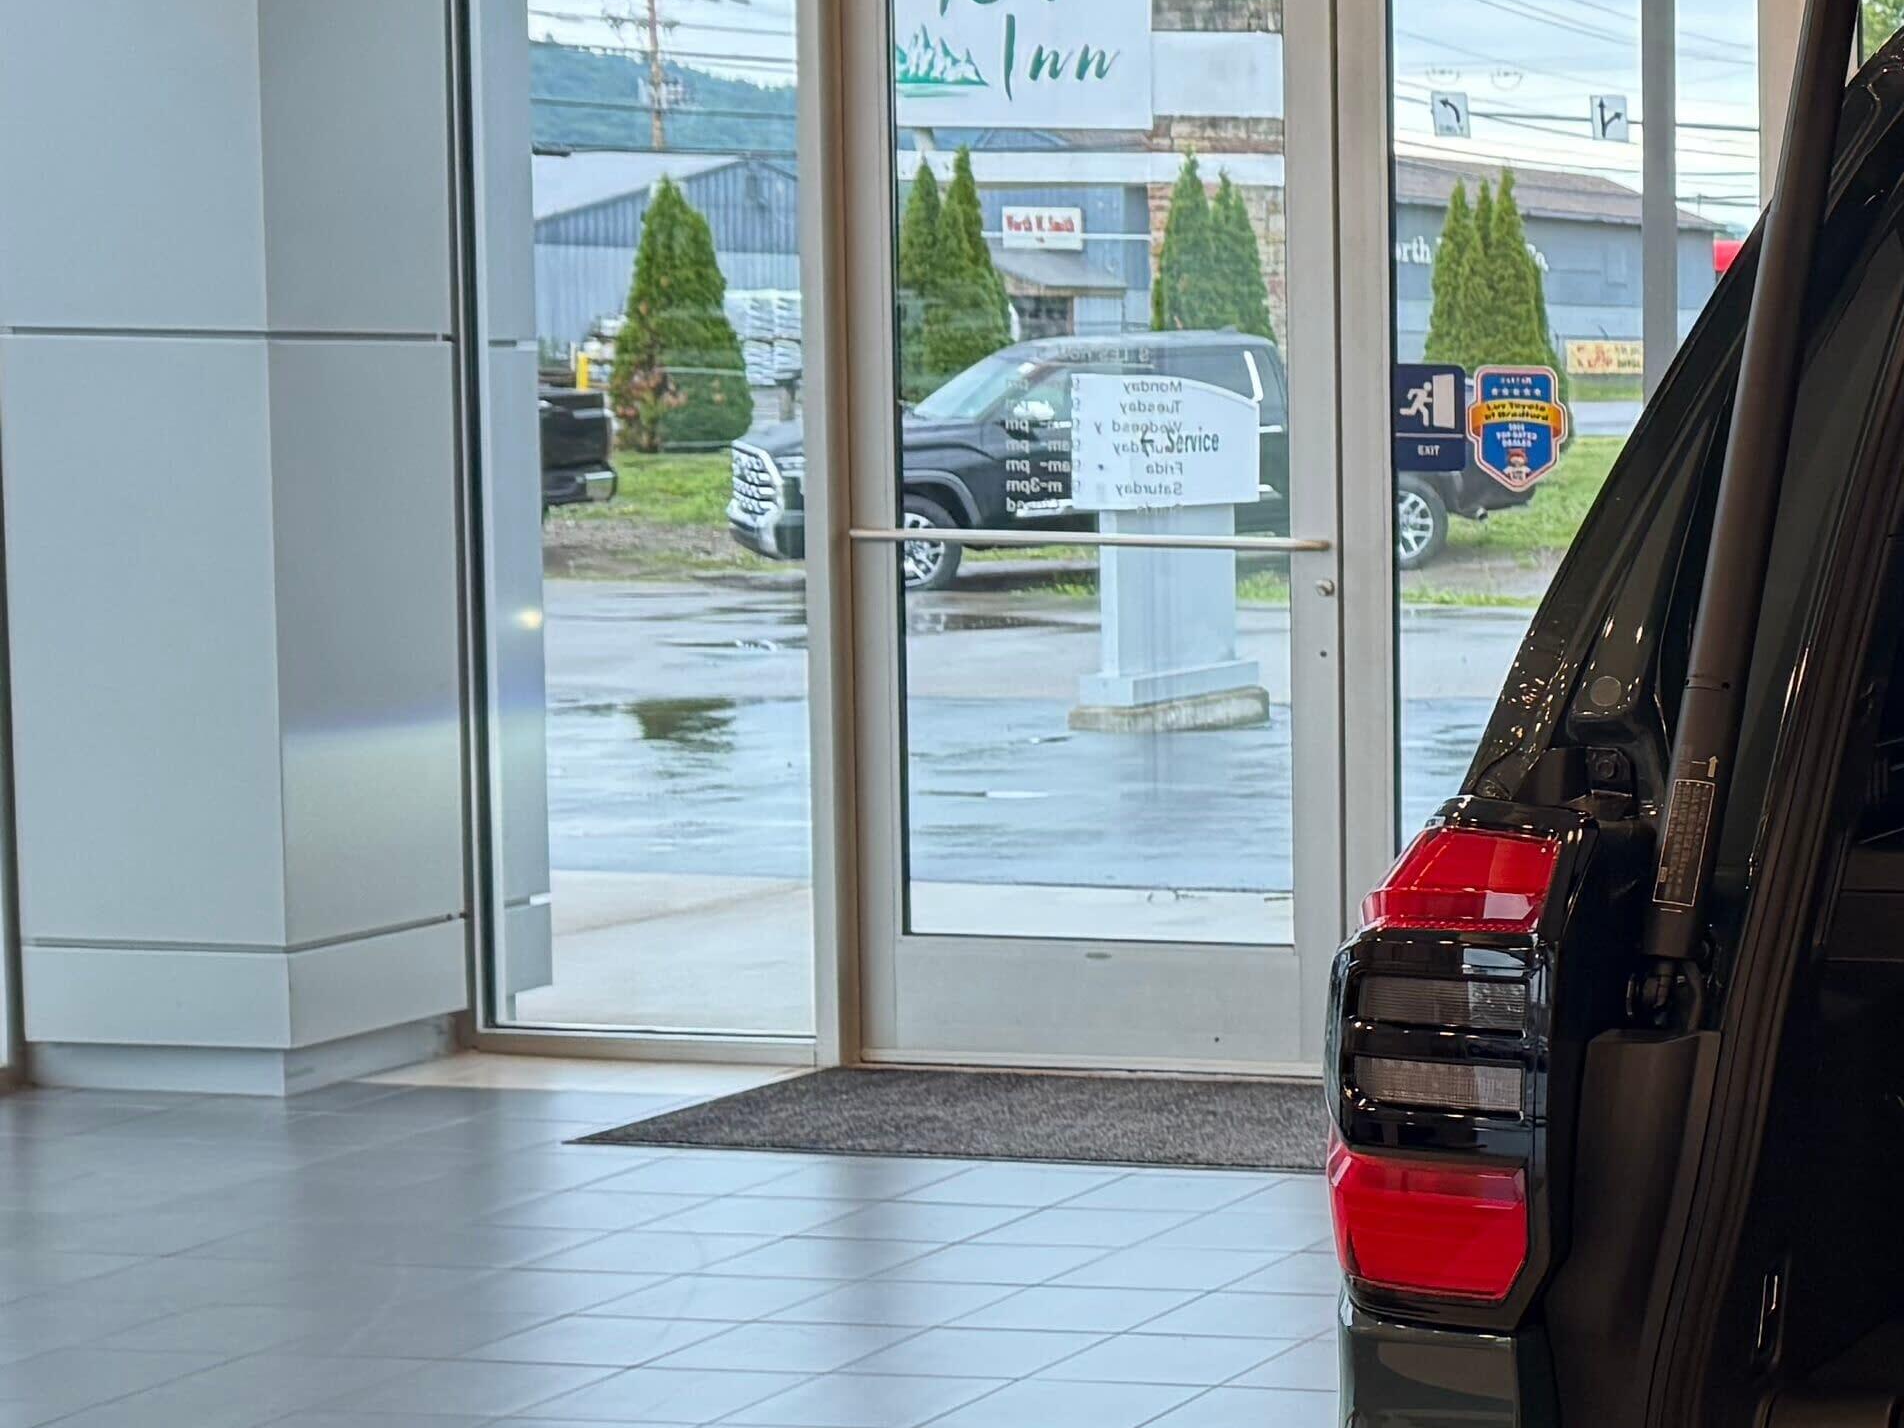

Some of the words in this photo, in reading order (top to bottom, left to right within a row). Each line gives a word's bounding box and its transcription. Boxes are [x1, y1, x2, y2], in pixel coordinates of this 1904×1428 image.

[1003, 13, 1121, 101] Inn
[1167, 426, 1220, 453] Service
[1417, 445, 1440, 457] EXIT
